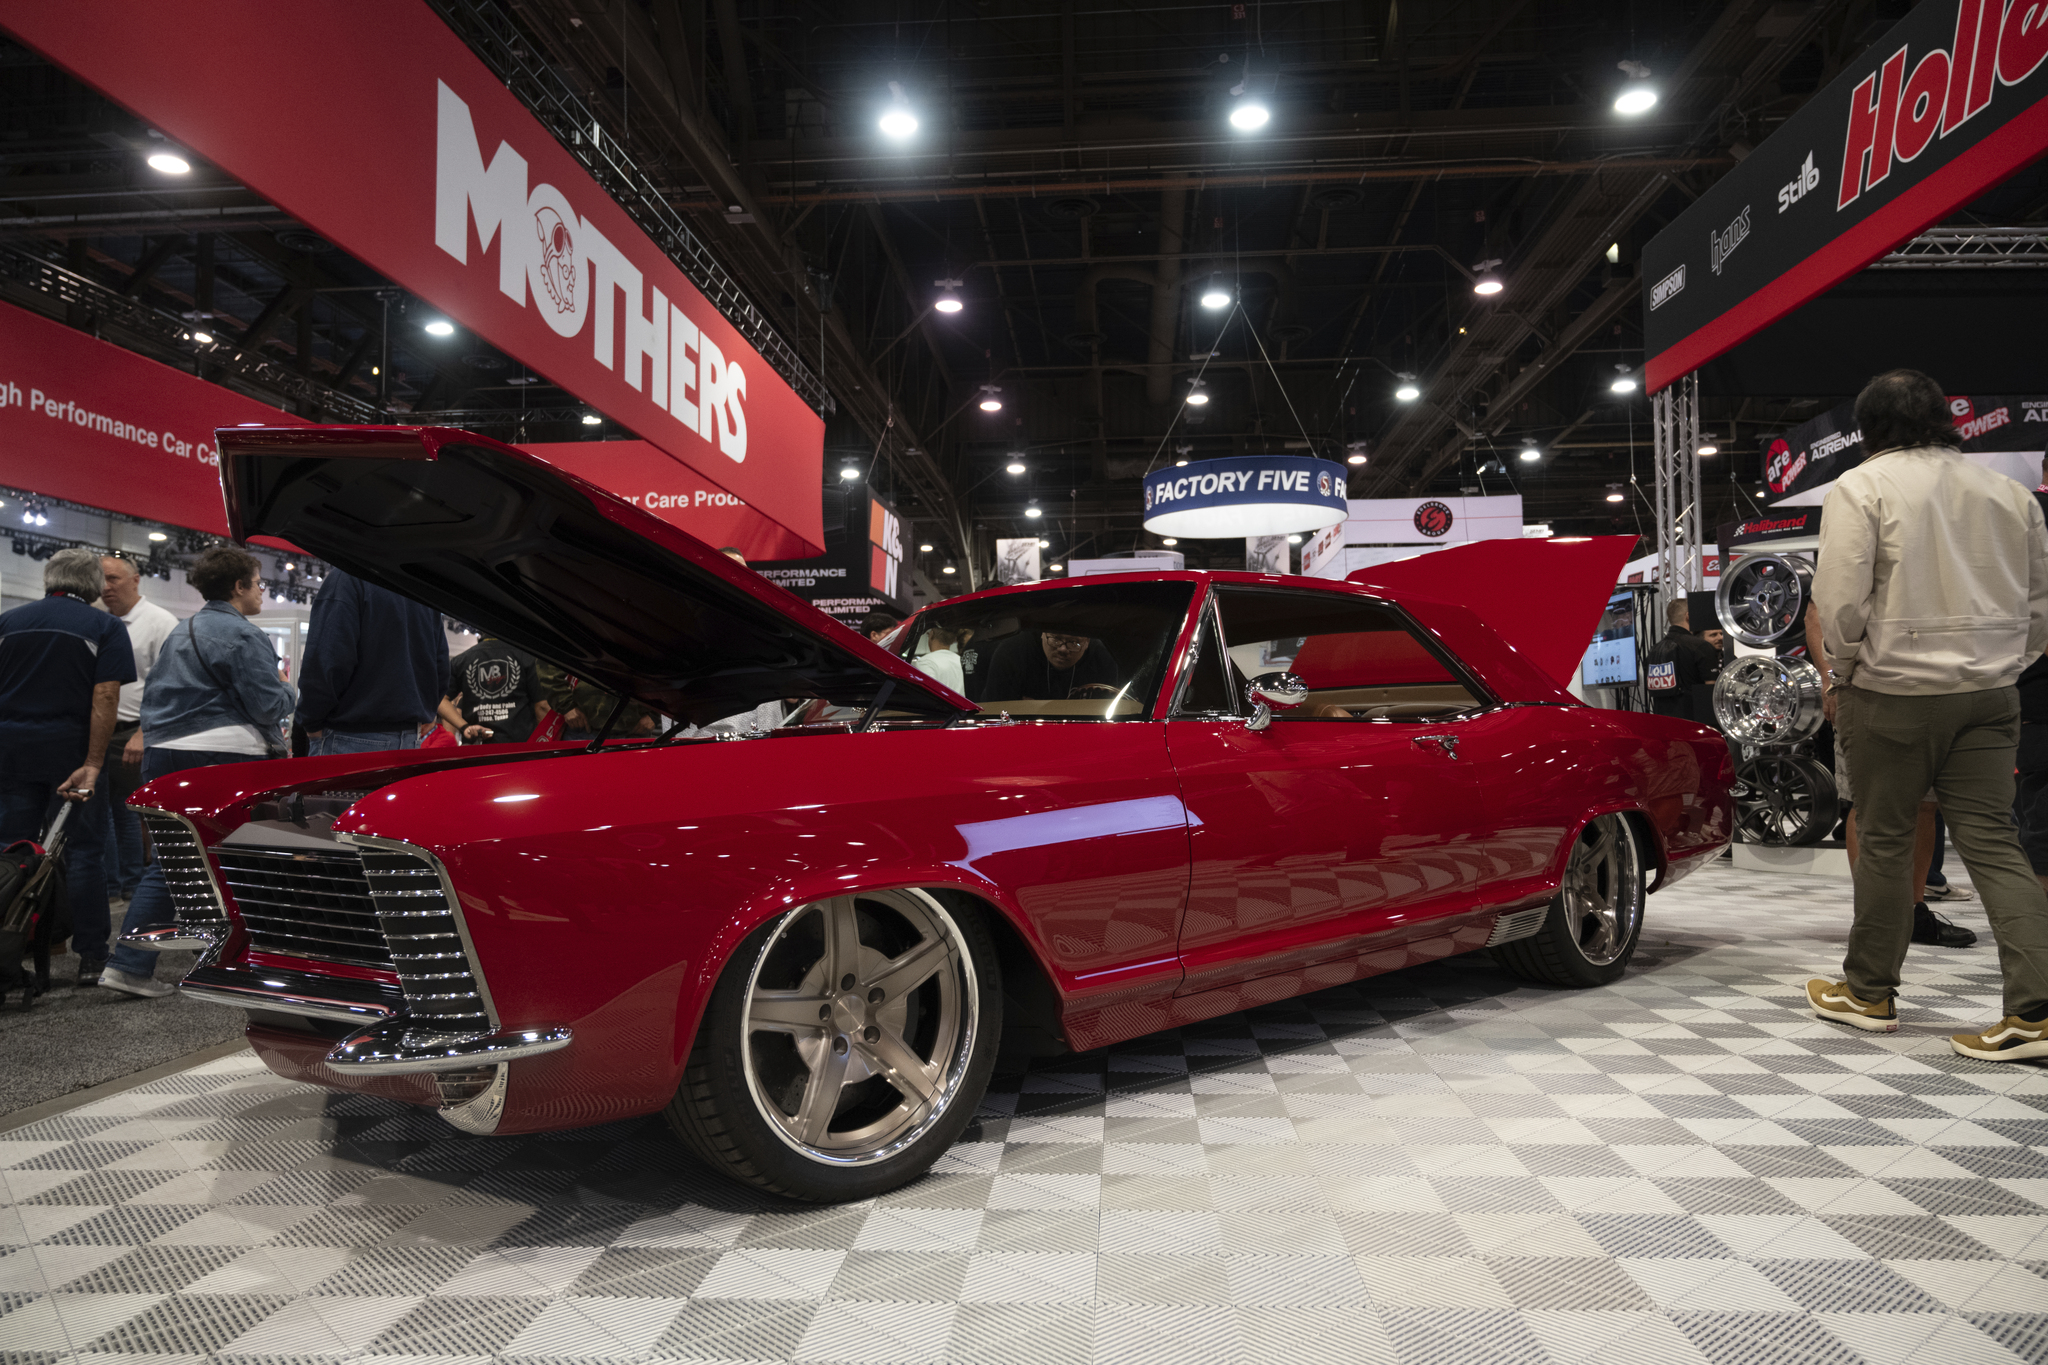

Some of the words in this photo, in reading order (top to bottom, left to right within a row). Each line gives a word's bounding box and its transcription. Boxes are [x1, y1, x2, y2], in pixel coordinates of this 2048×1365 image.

[435, 77, 747, 464] MOTHERS
[1652, 269, 1684, 308] SIMPSON
[30, 387, 158, 448] Performance
[162, 431, 193, 458] Car
[1767, 450, 1790, 482] aFe
[1781, 451, 1807, 492] POWER
[645, 491, 689, 509] Care
[1155, 470, 1254, 505] FACTORY
[1257, 470, 1310, 491] FIVE
[1416, 502, 1450, 515] EDELBROCK
[1743, 514, 1808, 535] Halibrand
[1422, 528, 1445, 536] GROUP
[818, 605, 871, 614] NLIMITED
